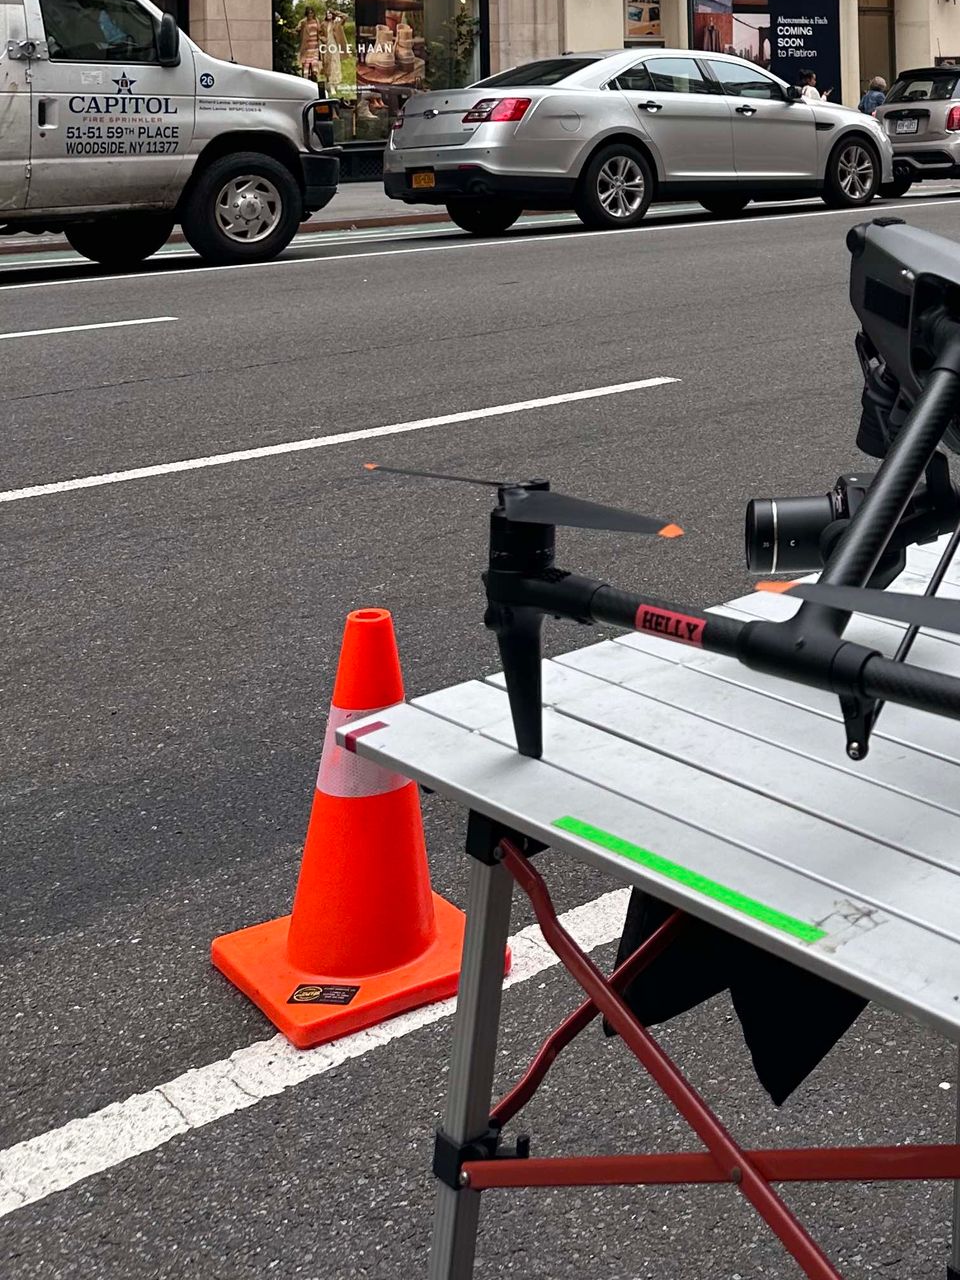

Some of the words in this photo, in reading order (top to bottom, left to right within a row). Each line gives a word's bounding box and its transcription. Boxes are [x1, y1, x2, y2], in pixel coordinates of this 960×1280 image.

[777, 26, 813, 35] COMING
[777, 37, 804, 47] SOON
[319, 43, 353, 54] COLE
[358, 43, 393, 54] HAAN
[778, 49, 787, 57] to
[788, 48, 817, 57] Flatiron
[201, 76, 214, 86] 26
[69, 96, 178, 115] CAPITOL
[66, 126, 103, 139] 51-51
[138, 126, 179, 139] PLACE
[65, 141, 128, 154] WOODSIDE,
[129, 141, 145, 153] NY
[146, 141, 179, 153] 11377
[641, 610, 700, 641] HELLY
